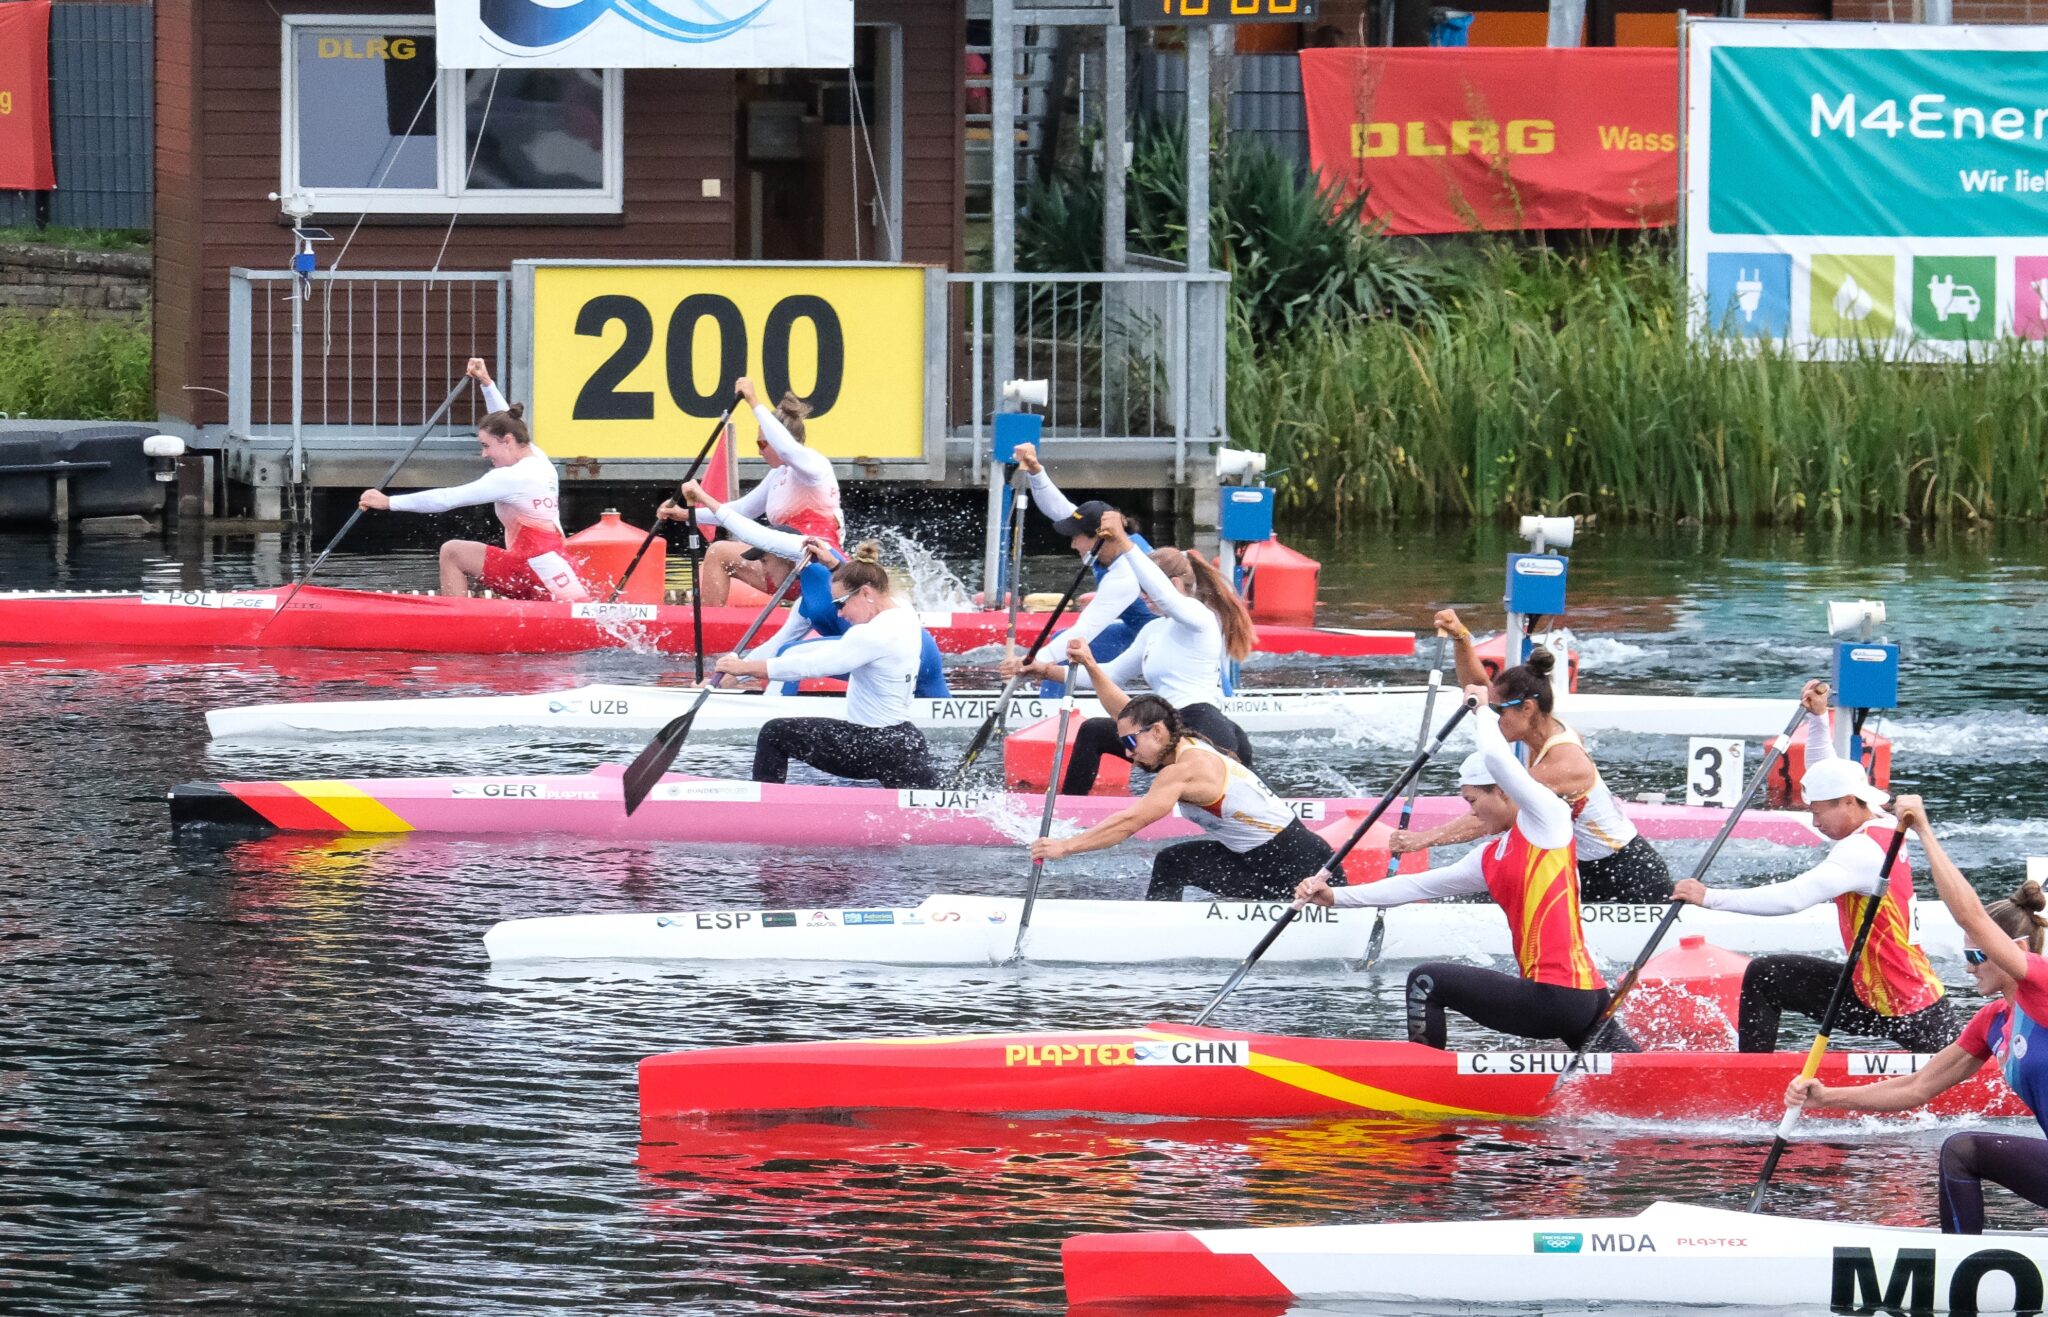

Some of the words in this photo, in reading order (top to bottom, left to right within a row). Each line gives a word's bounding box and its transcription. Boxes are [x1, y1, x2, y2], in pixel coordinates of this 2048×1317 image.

[318, 38, 417, 60] DLRG
[1351, 119, 1556, 158] DLRG
[1598, 125, 1689, 152] Wass
[1959, 169, 2009, 192] Wir
[2015, 169, 2048, 192] lie
[572, 292, 845, 421] 200
[533, 497, 558, 509] PO
[169, 592, 212, 607] POL
[590, 700, 629, 715] UZB
[931, 700, 1023, 719] FAYZIEA
[1029, 701, 1049, 719] G.
[1220, 701, 1269, 713] KIROVA
[1693, 746, 1722, 797] 3
[483, 784, 537, 797] GER
[909, 790, 927, 807] L.
[1206, 902, 1229, 920] A.
[1581, 905, 1682, 923] ORBER
[696, 913, 751, 929] ESP
[1006, 1044, 1135, 1067] PLASTEX
[1172, 1042, 1237, 1064] CHN
[1472, 1054, 1497, 1073] C.
[1864, 1055, 1898, 1074] W.
[1592, 1234, 1656, 1252] MDA
[1830, 1246, 2044, 1314] MO
